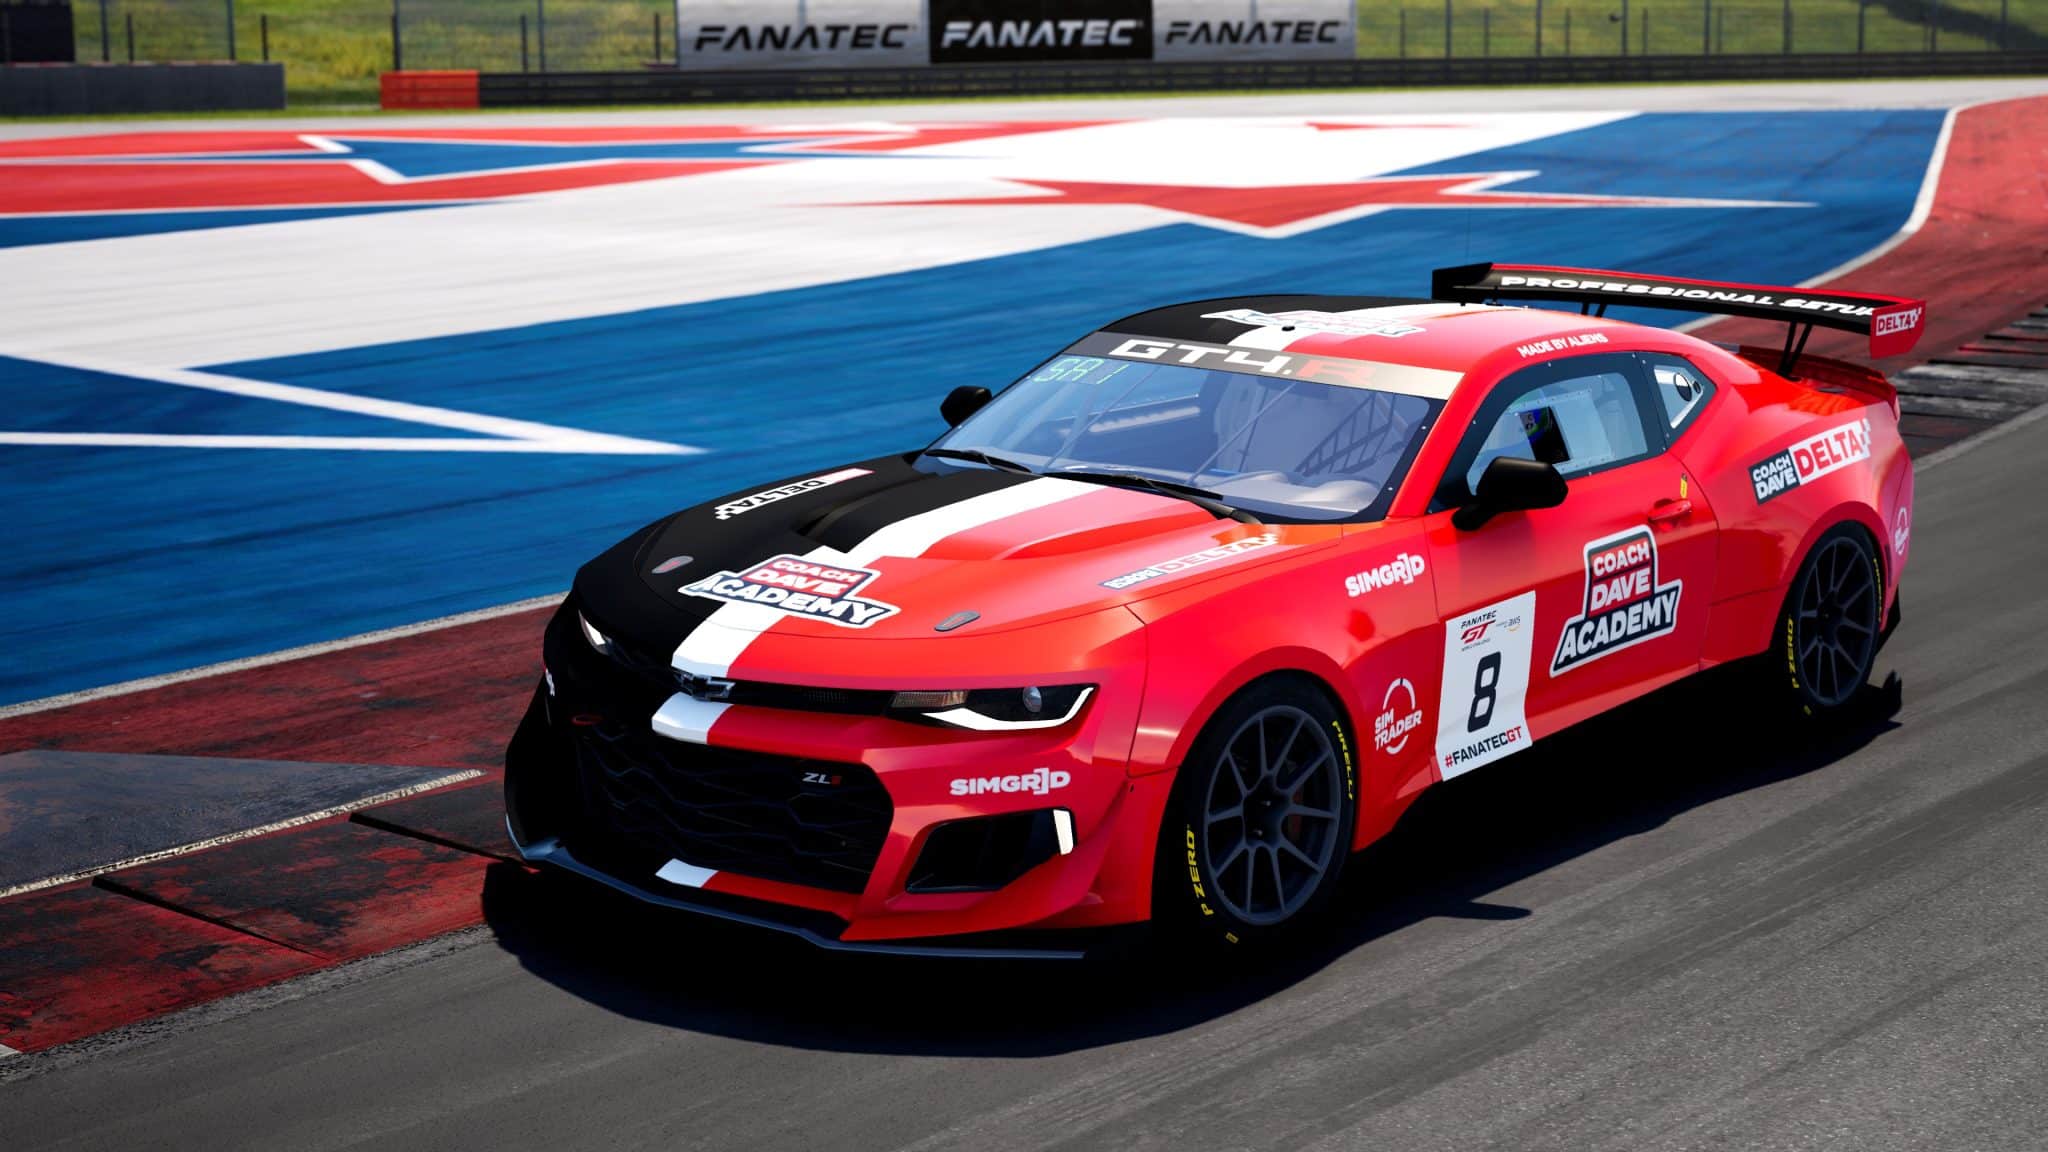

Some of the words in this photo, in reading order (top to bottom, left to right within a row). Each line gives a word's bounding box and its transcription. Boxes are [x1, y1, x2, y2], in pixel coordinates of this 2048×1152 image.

[695, 25, 910, 50] FANATEC
[941, 19, 1138, 48] FANATEC
[1165, 21, 1341, 45] FANATEC
[1501, 276, 1775, 306] PROFESSIONAL
[1878, 314, 1911, 332] DELTA
[1517, 340, 1554, 358] MADE
[1550, 337, 1569, 351] BY
[1567, 332, 1609, 348] ALIENS
[1794, 429, 1862, 478] DELTA
[1753, 455, 1791, 482] COACH
[732, 479, 827, 510] DELTA
[1755, 469, 1798, 500] DAVE
[1156, 542, 1259, 571] DELTA
[1592, 541, 1651, 576] COACH
[748, 568, 850, 596] DAVE
[771, 560, 867, 583] COACH
[693, 575, 886, 624] ACADEMY
[1590, 567, 1651, 612] DAVE
[1460, 610, 1498, 629] FANATEC
[1460, 619, 1497, 644] GT
[1557, 591, 1676, 665] ACADEMY
[1467, 651, 1502, 733] 8
[1374, 707, 1395, 735] SIM
[1374, 709, 1422, 751] TRADER
[1445, 725, 1522, 769] #FANATECGT
[1186, 829, 1206, 899] ZERO
